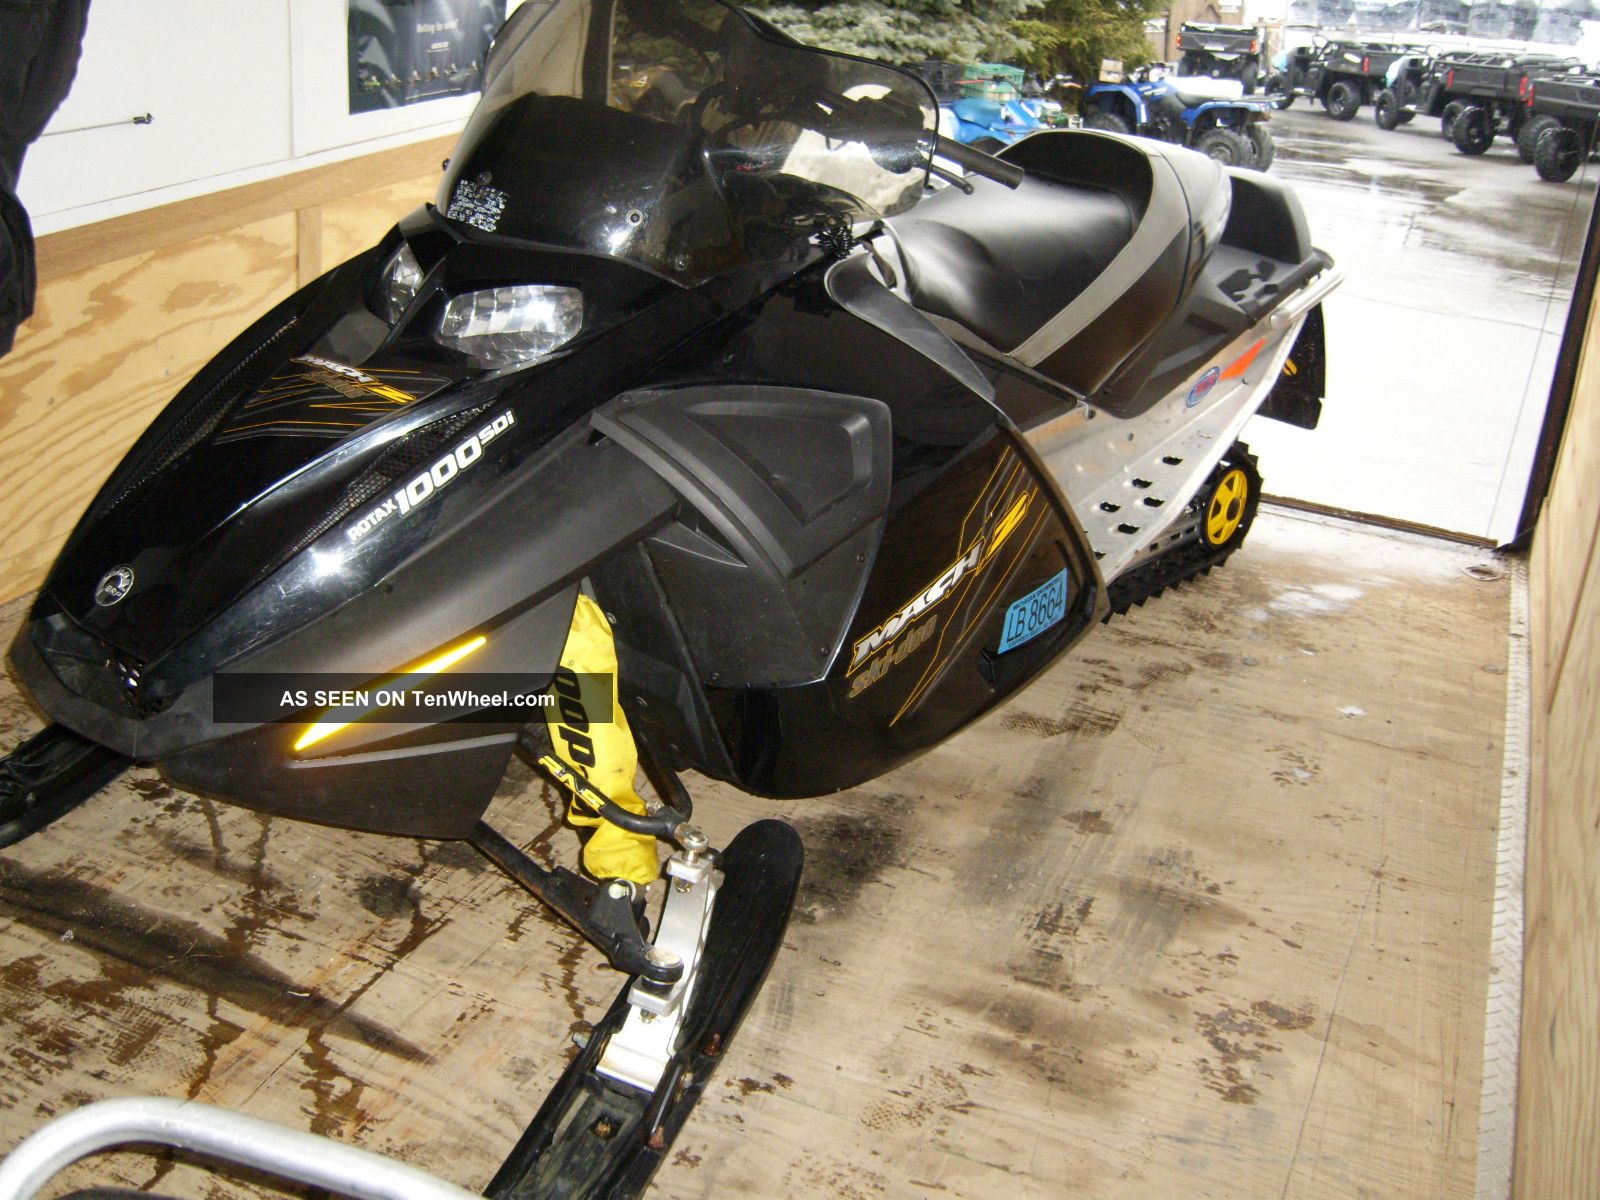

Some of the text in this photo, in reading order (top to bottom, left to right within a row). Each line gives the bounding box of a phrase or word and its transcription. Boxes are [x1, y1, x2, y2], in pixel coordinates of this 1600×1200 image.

[345, 498, 398, 545] ROTAX
[394, 436, 483, 516] 1000
[105, 585, 122, 597] BRP
[851, 540, 984, 669] MACH
[1006, 606, 1027, 643] LB
[1027, 580, 1063, 632] 8664
